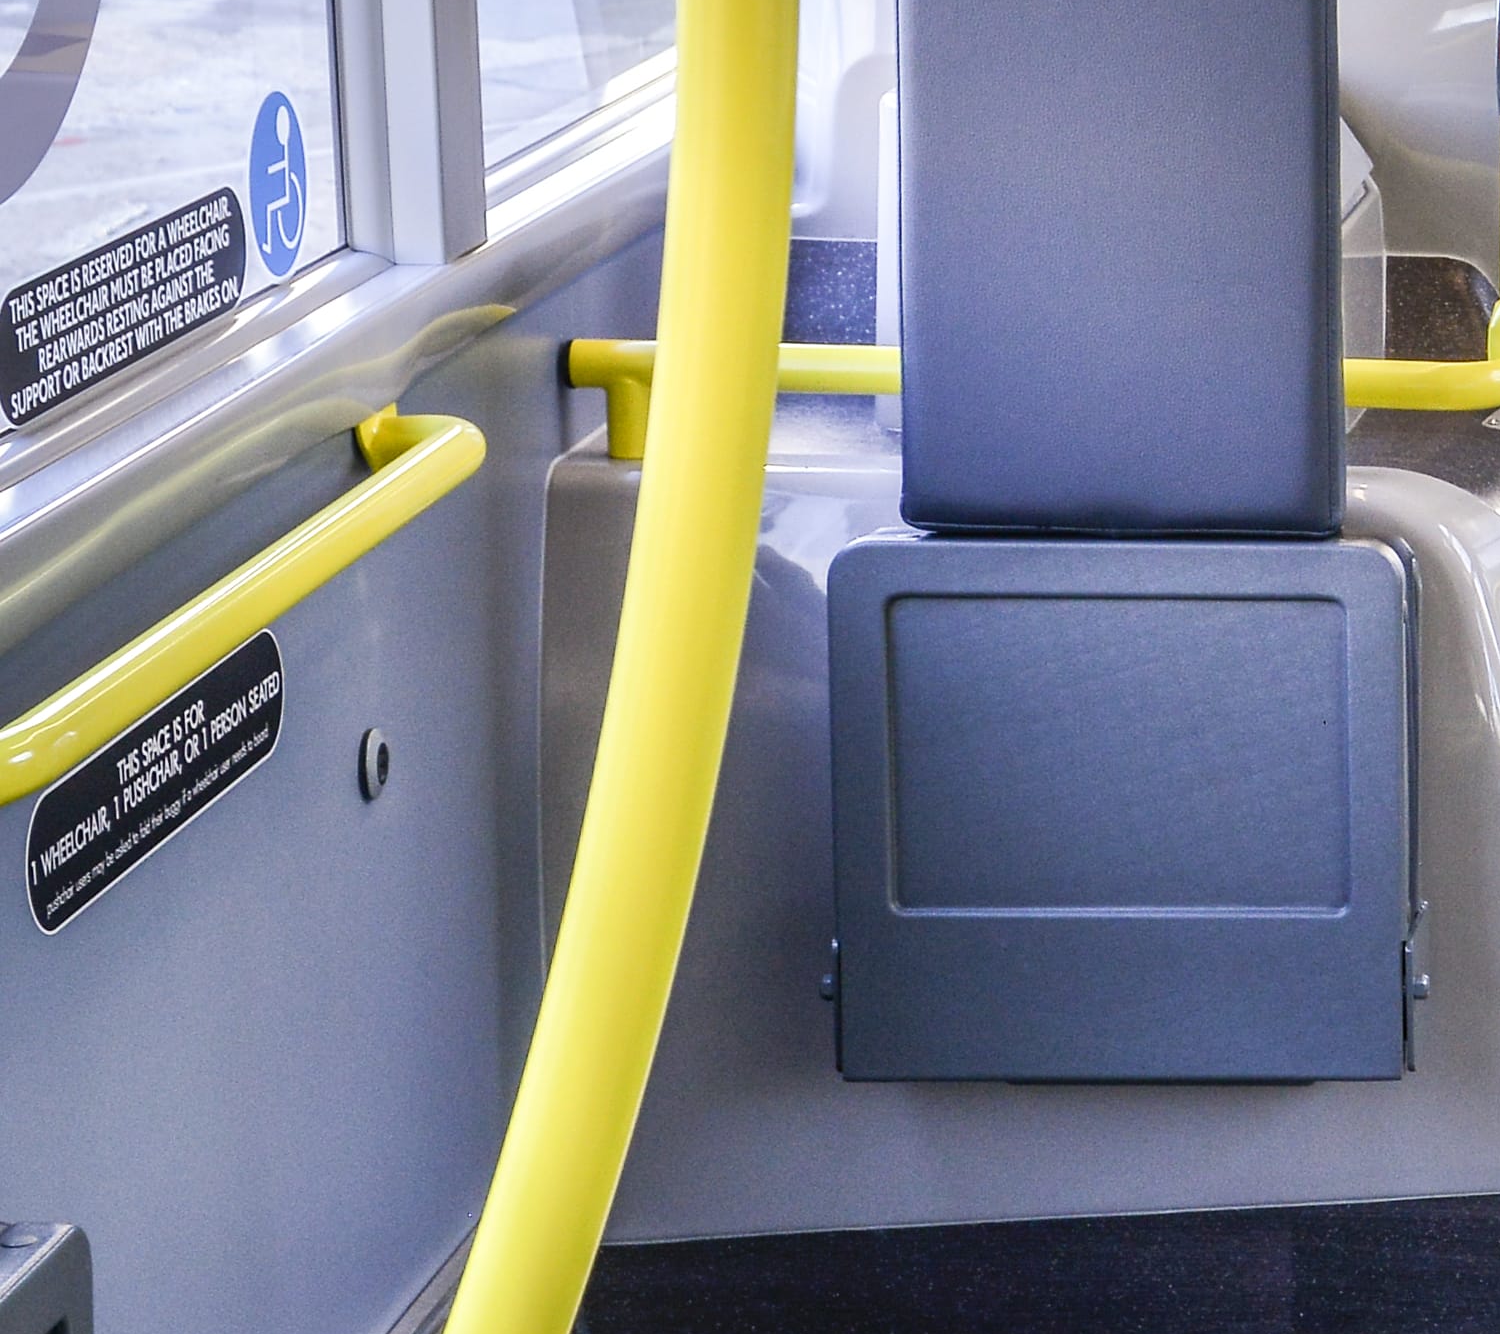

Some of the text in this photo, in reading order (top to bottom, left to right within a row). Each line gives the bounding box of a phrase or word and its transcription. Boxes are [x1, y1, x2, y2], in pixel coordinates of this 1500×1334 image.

[9, 195, 233, 325] THIS SPACE IS RESERVED FOR A WHEELCHAIR.
[15, 223, 231, 354] THE WHEELCHAIR MUST BE PLACED FACING
[37, 259, 216, 374] REARWARDS RESTING AGAINST THE
[9, 366, 63, 420] SUPPORT
[62, 356, 82, 390] OR
[80, 331, 136, 376] BACKREST
[134, 316, 165, 351] WITH
[162, 304, 186, 335] THE
[183, 288, 222, 325] BRAKES
[30, 670, 282, 887] 1 WHEELCHAIR, 1 PUSHCHAIR, OR 1 PERSON SEATED
[116, 698, 207, 786] THIS SPACE IS FOR
[114, 831, 133, 862] asked
